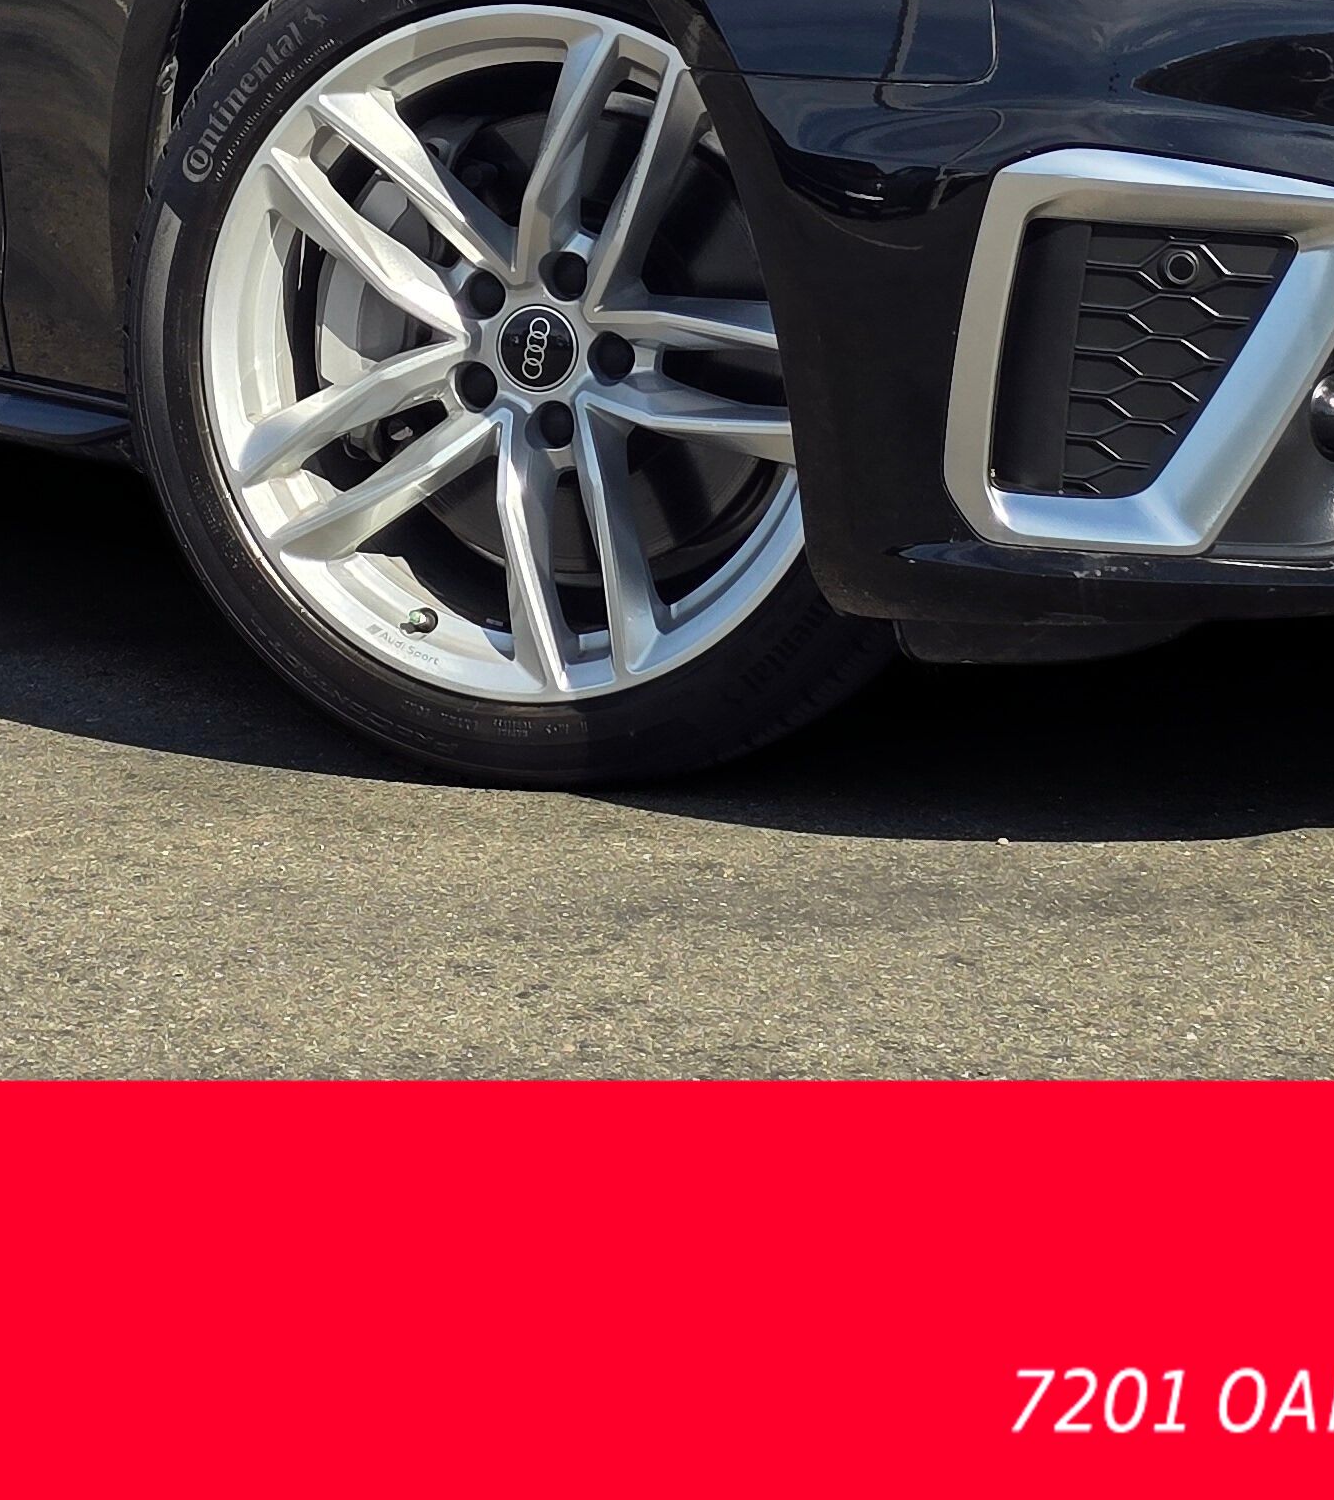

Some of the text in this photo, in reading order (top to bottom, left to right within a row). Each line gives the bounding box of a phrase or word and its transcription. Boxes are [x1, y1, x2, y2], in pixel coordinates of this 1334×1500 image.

[182, 21, 304, 183] Continental
[378, 631, 441, 666] Audi Sport
